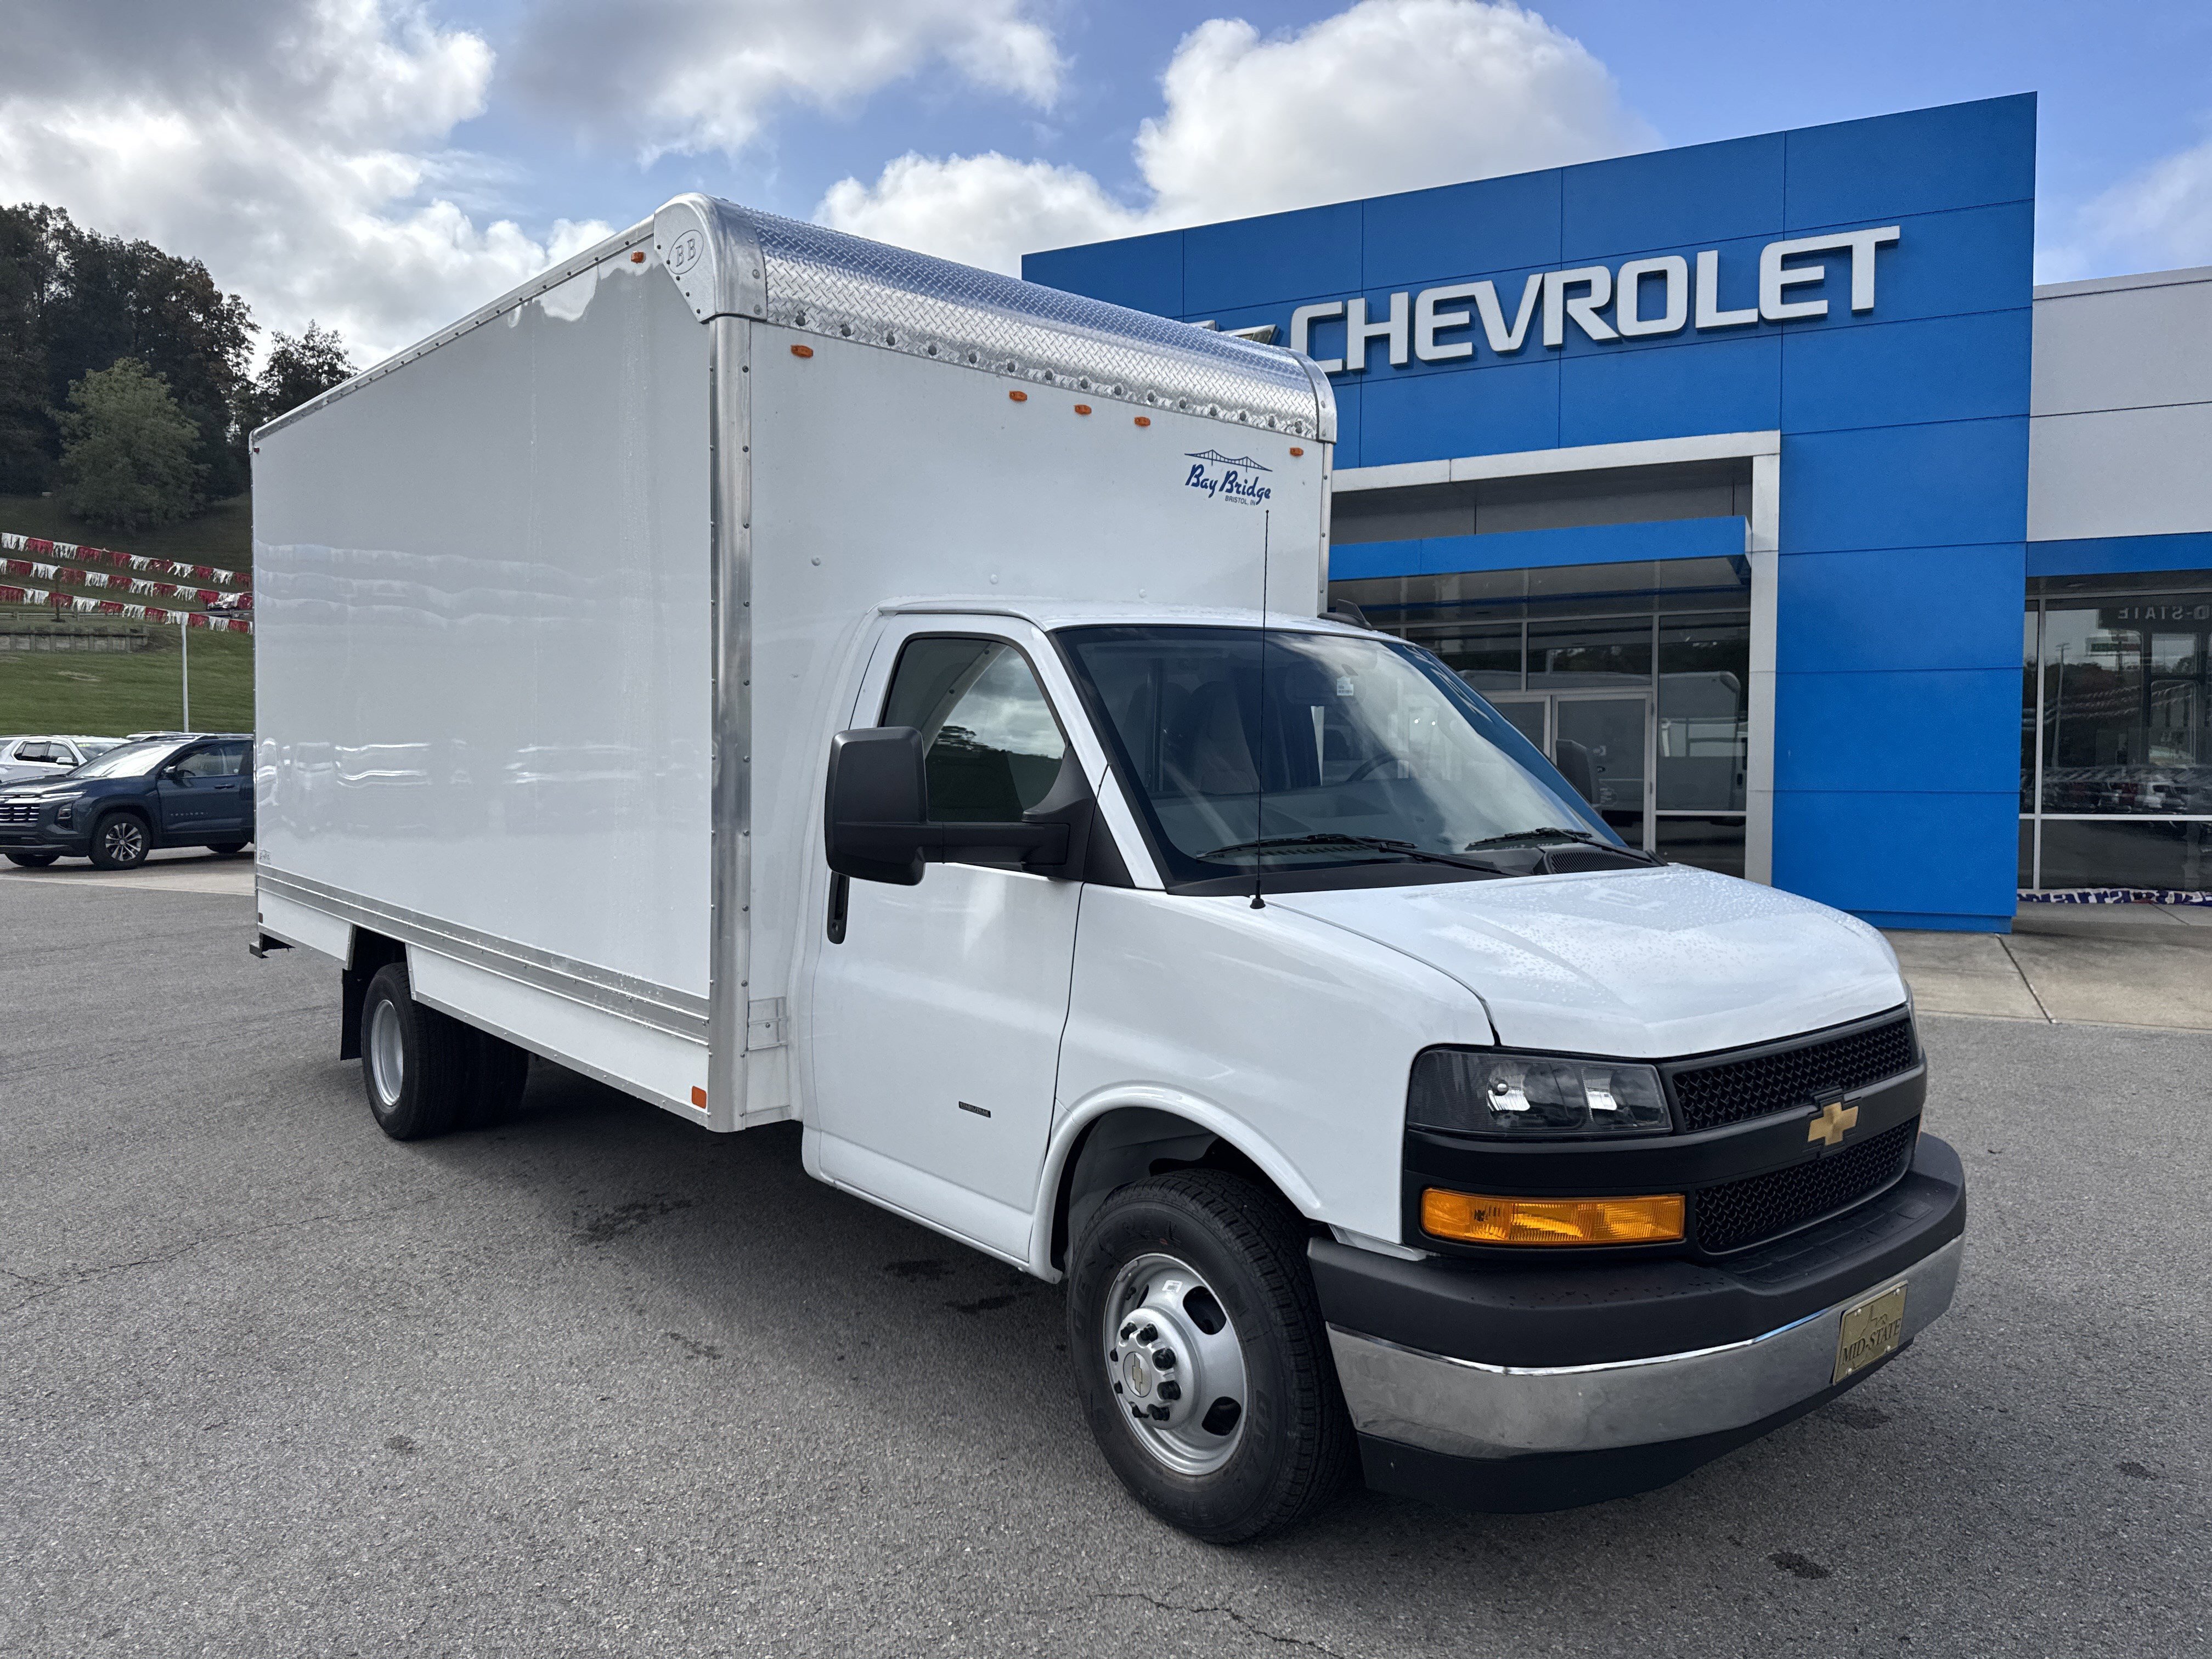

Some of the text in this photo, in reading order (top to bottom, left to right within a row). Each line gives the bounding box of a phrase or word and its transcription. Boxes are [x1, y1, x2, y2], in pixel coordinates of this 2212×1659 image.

[1291, 225, 1900, 373] CHEVROLET
[1185, 464, 1271, 505] Bay Bridge
[1224, 495, 1249, 505] BRISTOL,
[1841, 1317, 1901, 1365] MID-STATE
